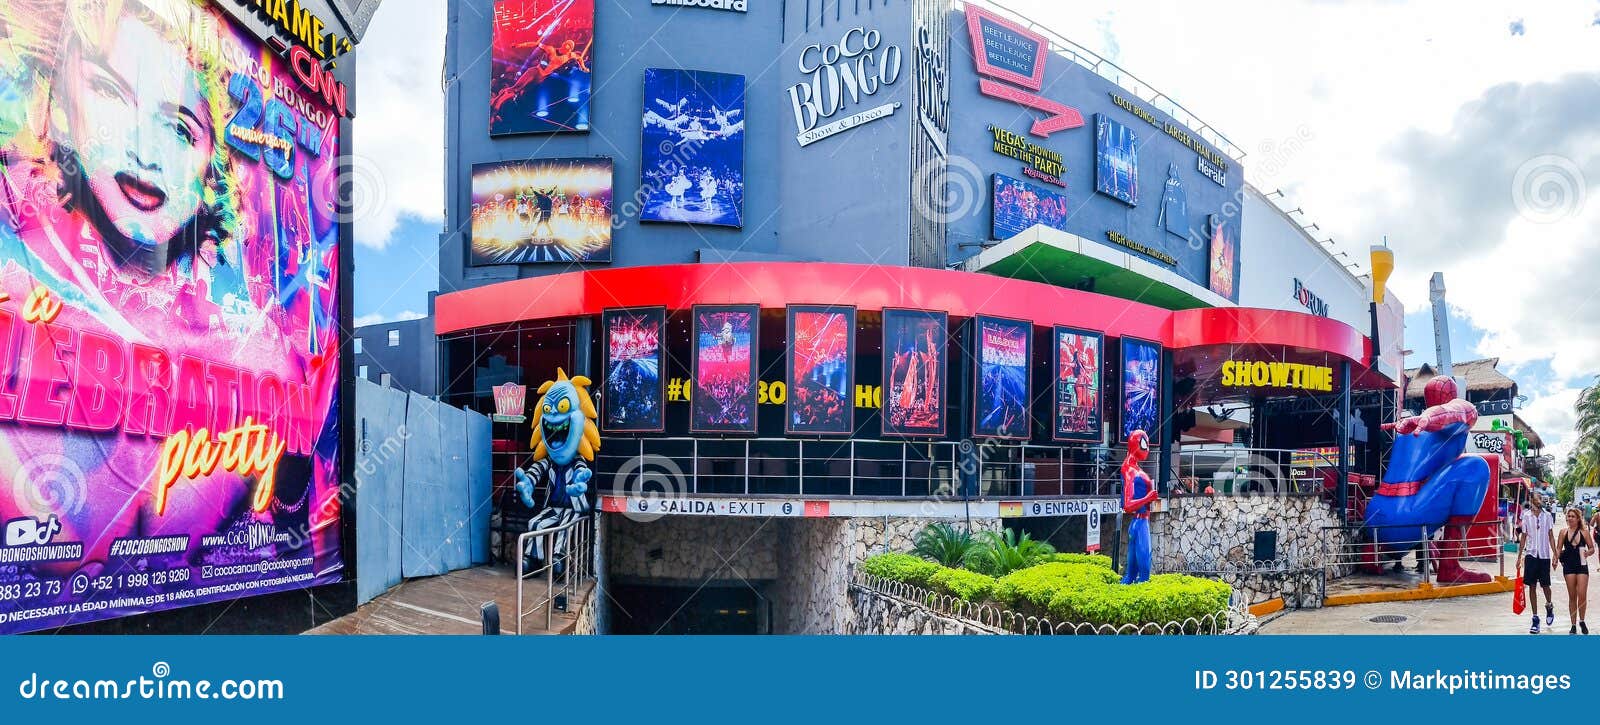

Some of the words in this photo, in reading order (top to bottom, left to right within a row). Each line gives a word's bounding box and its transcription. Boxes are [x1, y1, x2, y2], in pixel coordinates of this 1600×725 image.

[984, 25, 1033, 52] BEETLEJUICE
[985, 38, 1032, 63] BEETLEJUICE
[988, 51, 1029, 72] BEETLEJUICE
[273, 76, 327, 129] BONGO
[786, 45, 902, 134] BONGO
[804, 126, 835, 143] Show
[838, 120, 849, 131] &
[852, 108, 883, 126] Disco
[230, 122, 293, 162] anniversary
[994, 142, 1018, 158] MEETS
[1019, 149, 1032, 164] THE
[1192, 138, 1211, 161] THAN
[1198, 156, 1226, 188] Herald
[1293, 277, 1330, 318] FORUM
[1221, 359, 1333, 392] SHOWTIME
[157, 416, 287, 517] party
[660, 500, 715, 514] SALIDA
[729, 502, 766, 515] EXIT
[1046, 501, 1089, 515] ENTRAD
[110, 537, 189, 556] #COCOBONGOSHOW
[25, 582, 41, 598] 23
[45, 580, 61, 596] 73
[91, 575, 113, 590] +52
[117, 575, 123, 588] 1
[127, 574, 149, 587] 998
[152, 571, 167, 585] 126
[169, 568, 190, 582] 9260
[9, 605, 68, 622] NECESSARY.
[69, 603, 81, 613] LA
[83, 601, 108, 612] EDAD
[109, 597, 144, 609] MÍNIMA
[145, 596, 155, 605] ES
[155, 595, 165, 603] DE
[175, 589, 196, 600] AÑOS,
[196, 582, 245, 597] IDENTIFICACIÓN
[245, 581, 260, 590] CON
